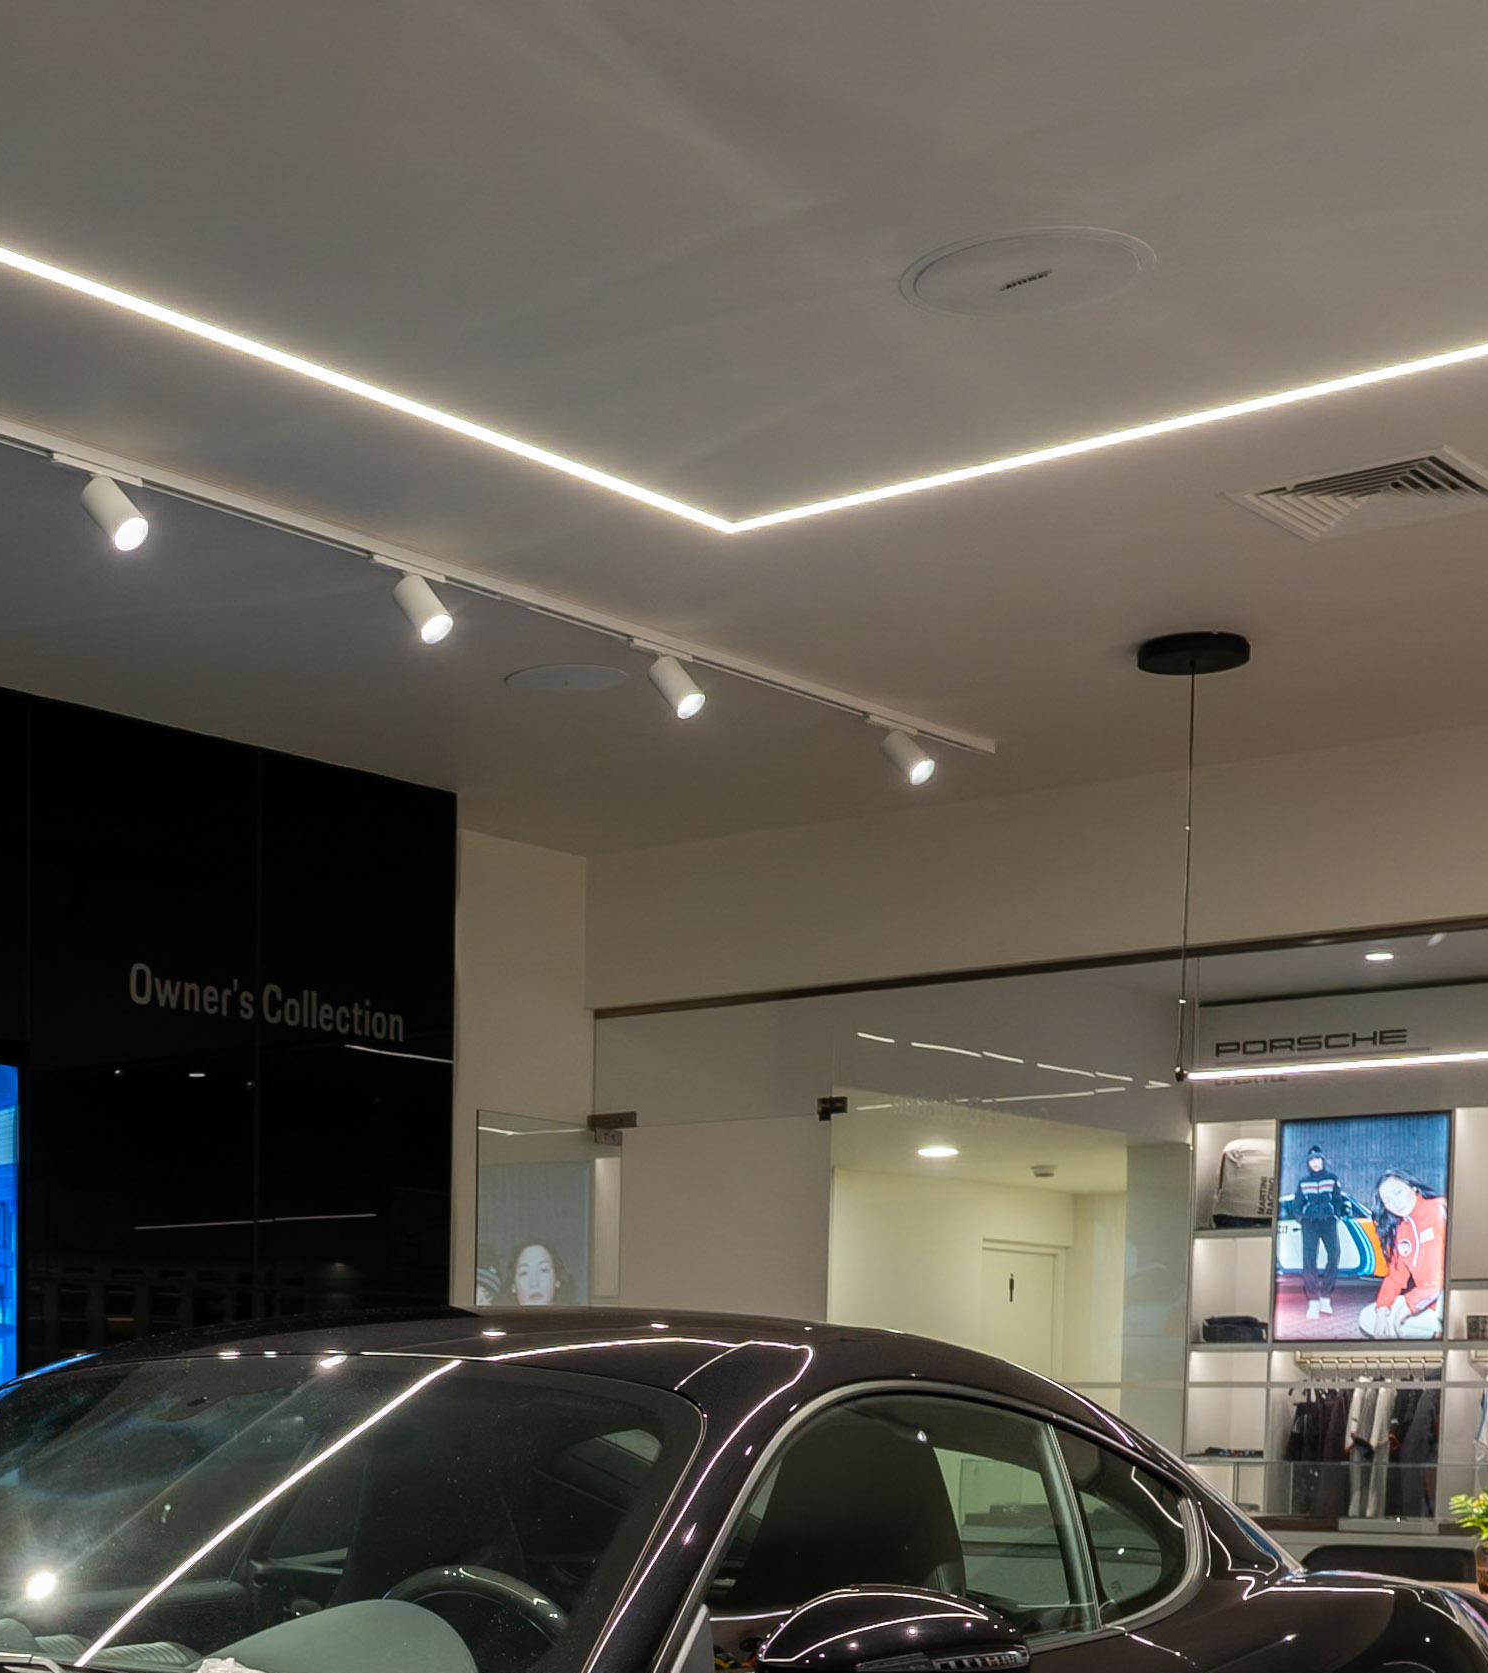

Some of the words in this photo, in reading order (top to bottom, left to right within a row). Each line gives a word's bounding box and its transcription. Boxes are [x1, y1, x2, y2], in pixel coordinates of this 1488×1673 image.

[129, 963, 254, 1020] Owner's
[262, 984, 404, 1042] Collection
[1215, 1028, 1408, 1057] PORSCHE
